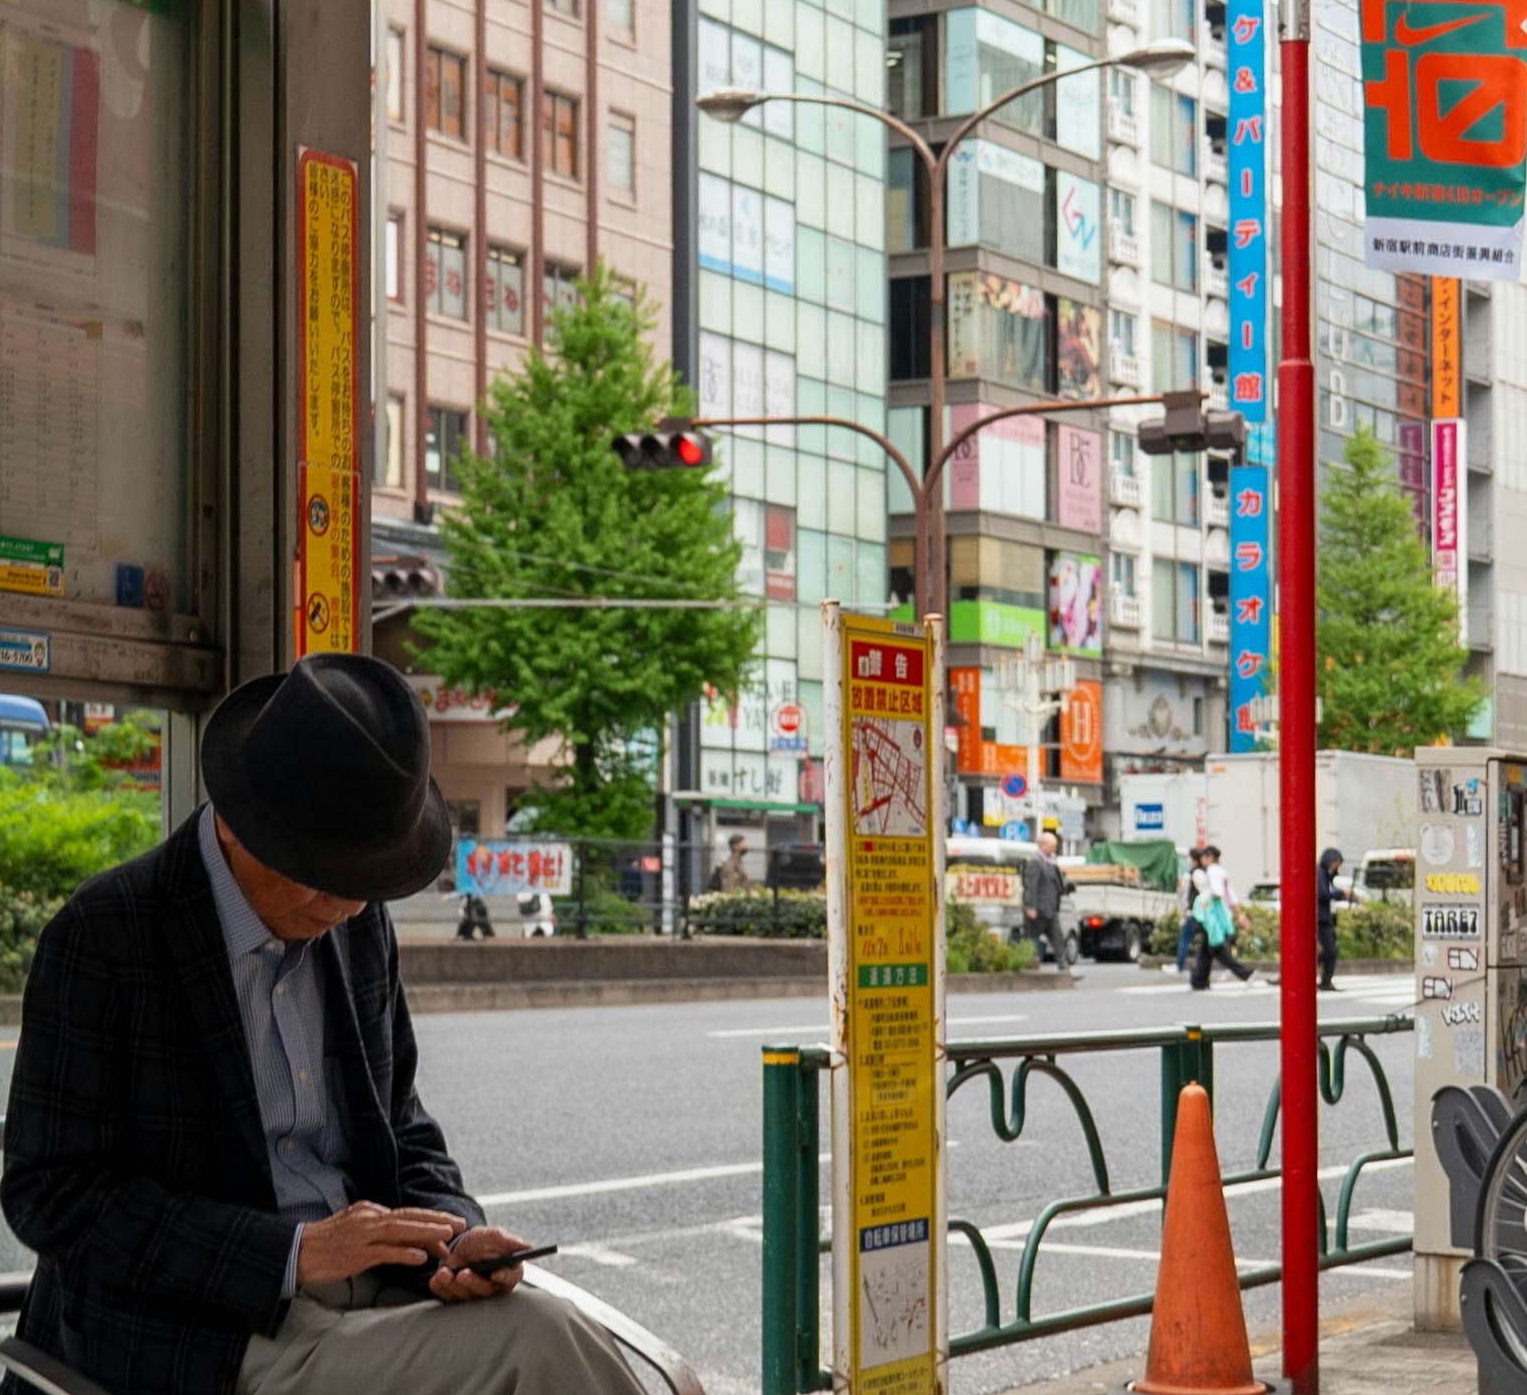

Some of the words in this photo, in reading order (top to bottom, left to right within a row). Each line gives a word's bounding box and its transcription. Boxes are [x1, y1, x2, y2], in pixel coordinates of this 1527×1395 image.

[1373, 237, 1515, 264] 新宿駅前商店街振興組合
[851, 683, 924, 716] 放置禁止区域
